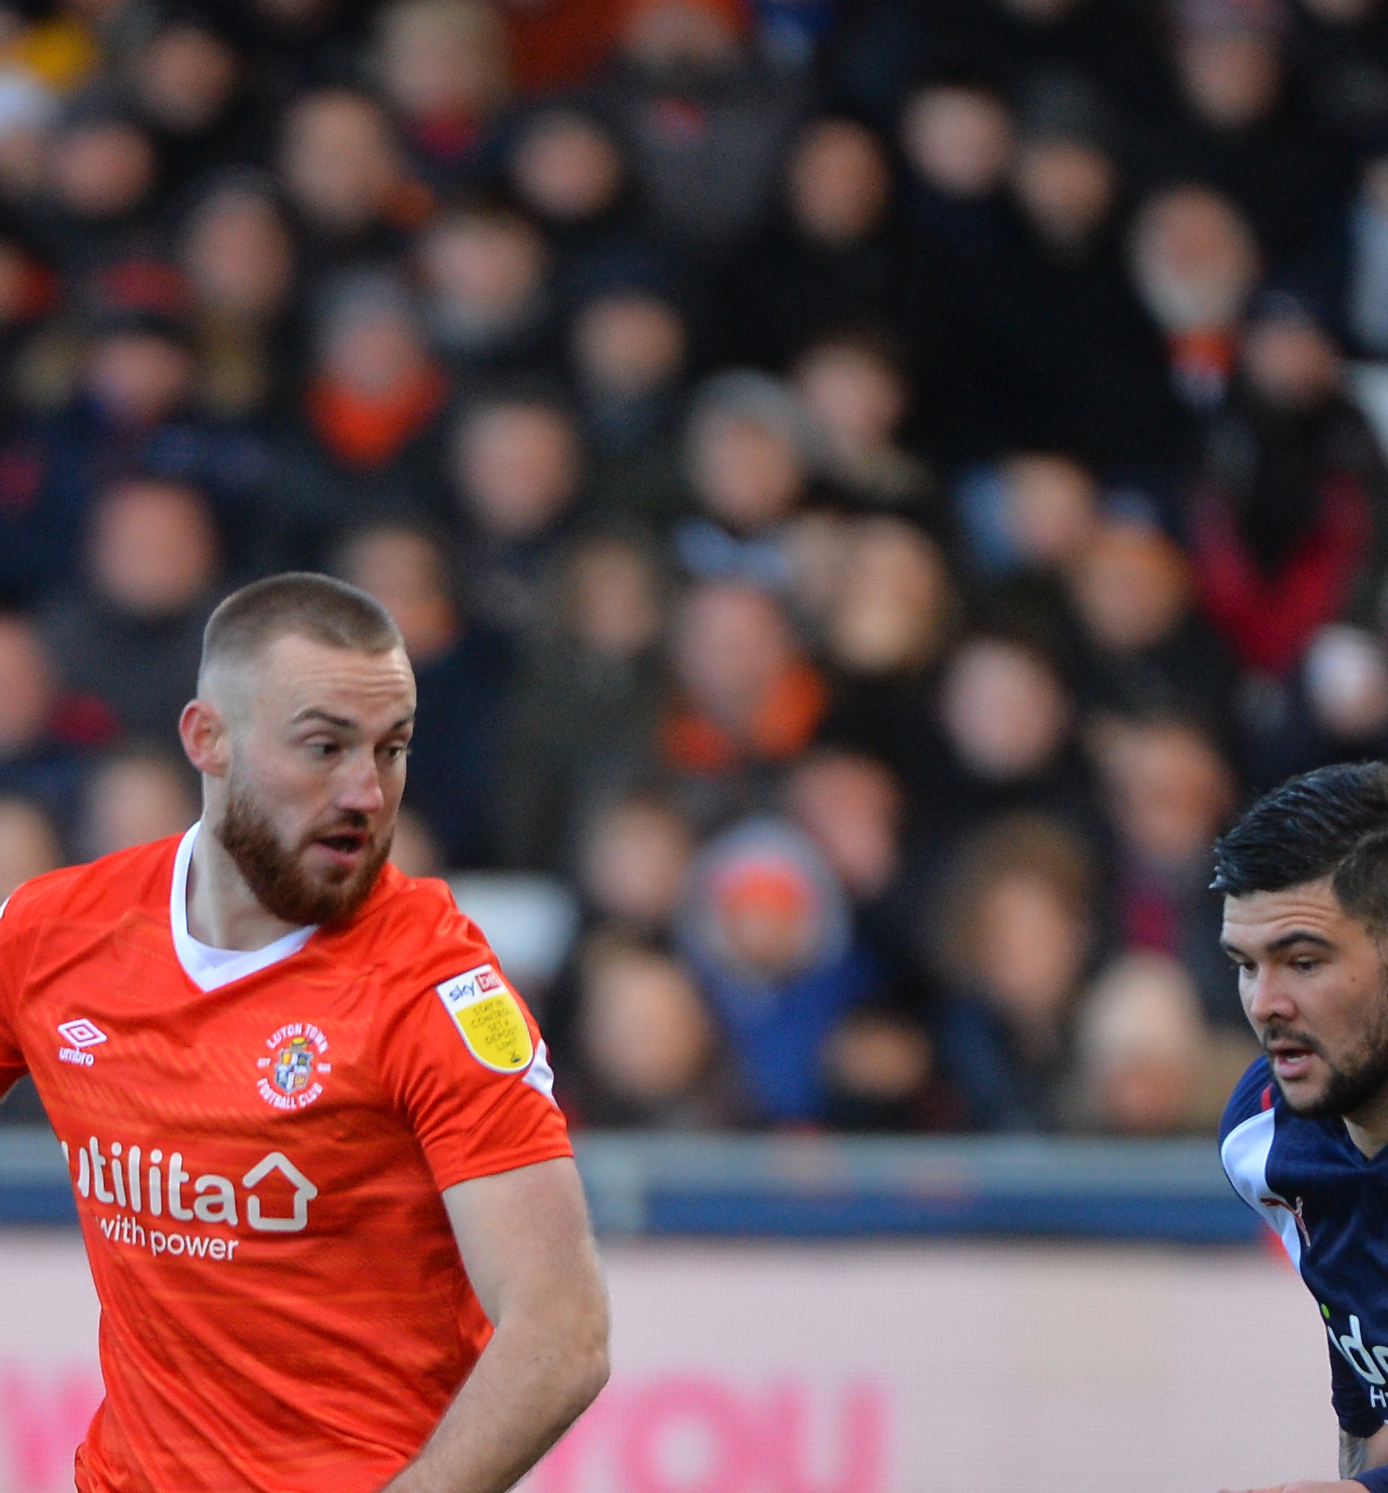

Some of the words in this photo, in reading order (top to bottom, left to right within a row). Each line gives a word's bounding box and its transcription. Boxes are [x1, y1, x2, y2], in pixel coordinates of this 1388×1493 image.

[449, 982, 475, 1001] sky
[266, 1023, 303, 1049] LUTON
[304, 1023, 328, 1055] TOWN
[59, 1047, 94, 1067] umbro
[257, 1078, 297, 1110] FOOTBALL
[298, 1082, 323, 1108] CLUB
[151, 1229, 239, 1261] power
